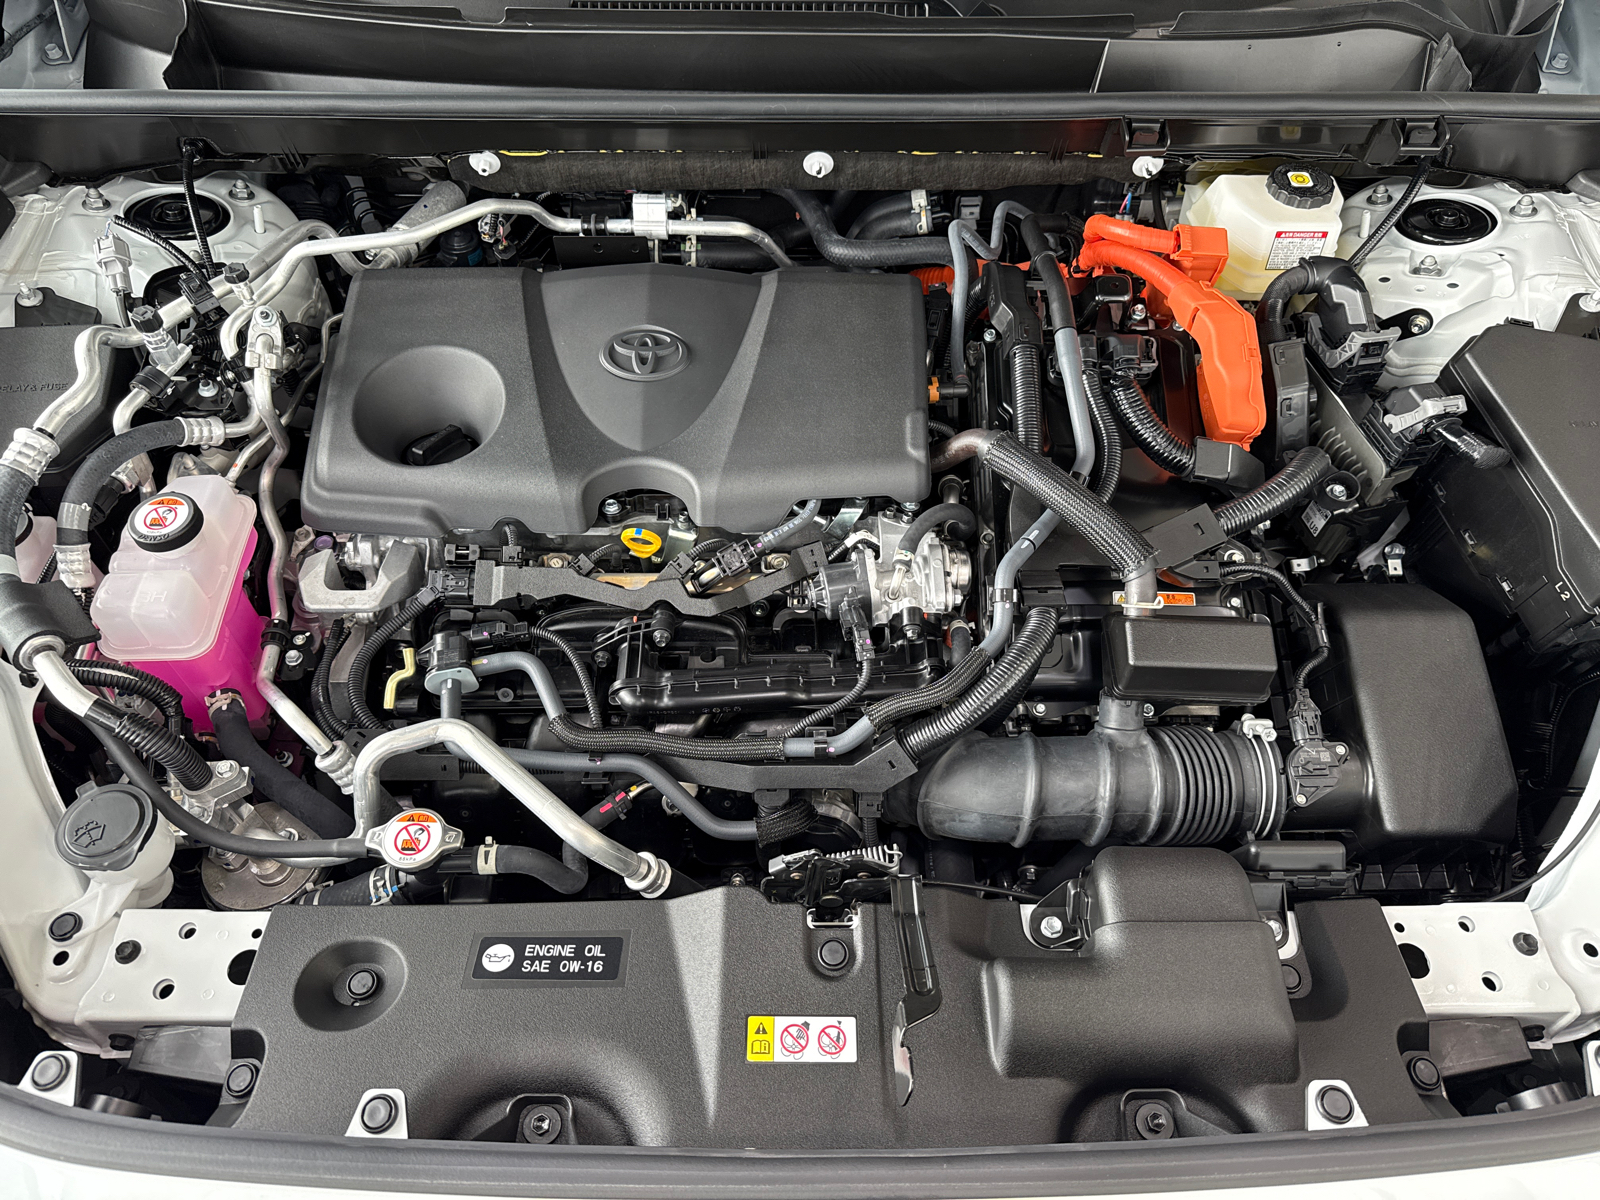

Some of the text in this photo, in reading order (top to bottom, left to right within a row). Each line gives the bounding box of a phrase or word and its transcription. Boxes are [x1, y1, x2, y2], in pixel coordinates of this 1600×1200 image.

[0, 384, 29, 393] ELAY
[40, 382, 69, 392] FUSE
[1555, 581, 1571, 602] L2
[524, 944, 606, 957] ENGINE OIL
[521, 960, 604, 973] SAE 0W-16
